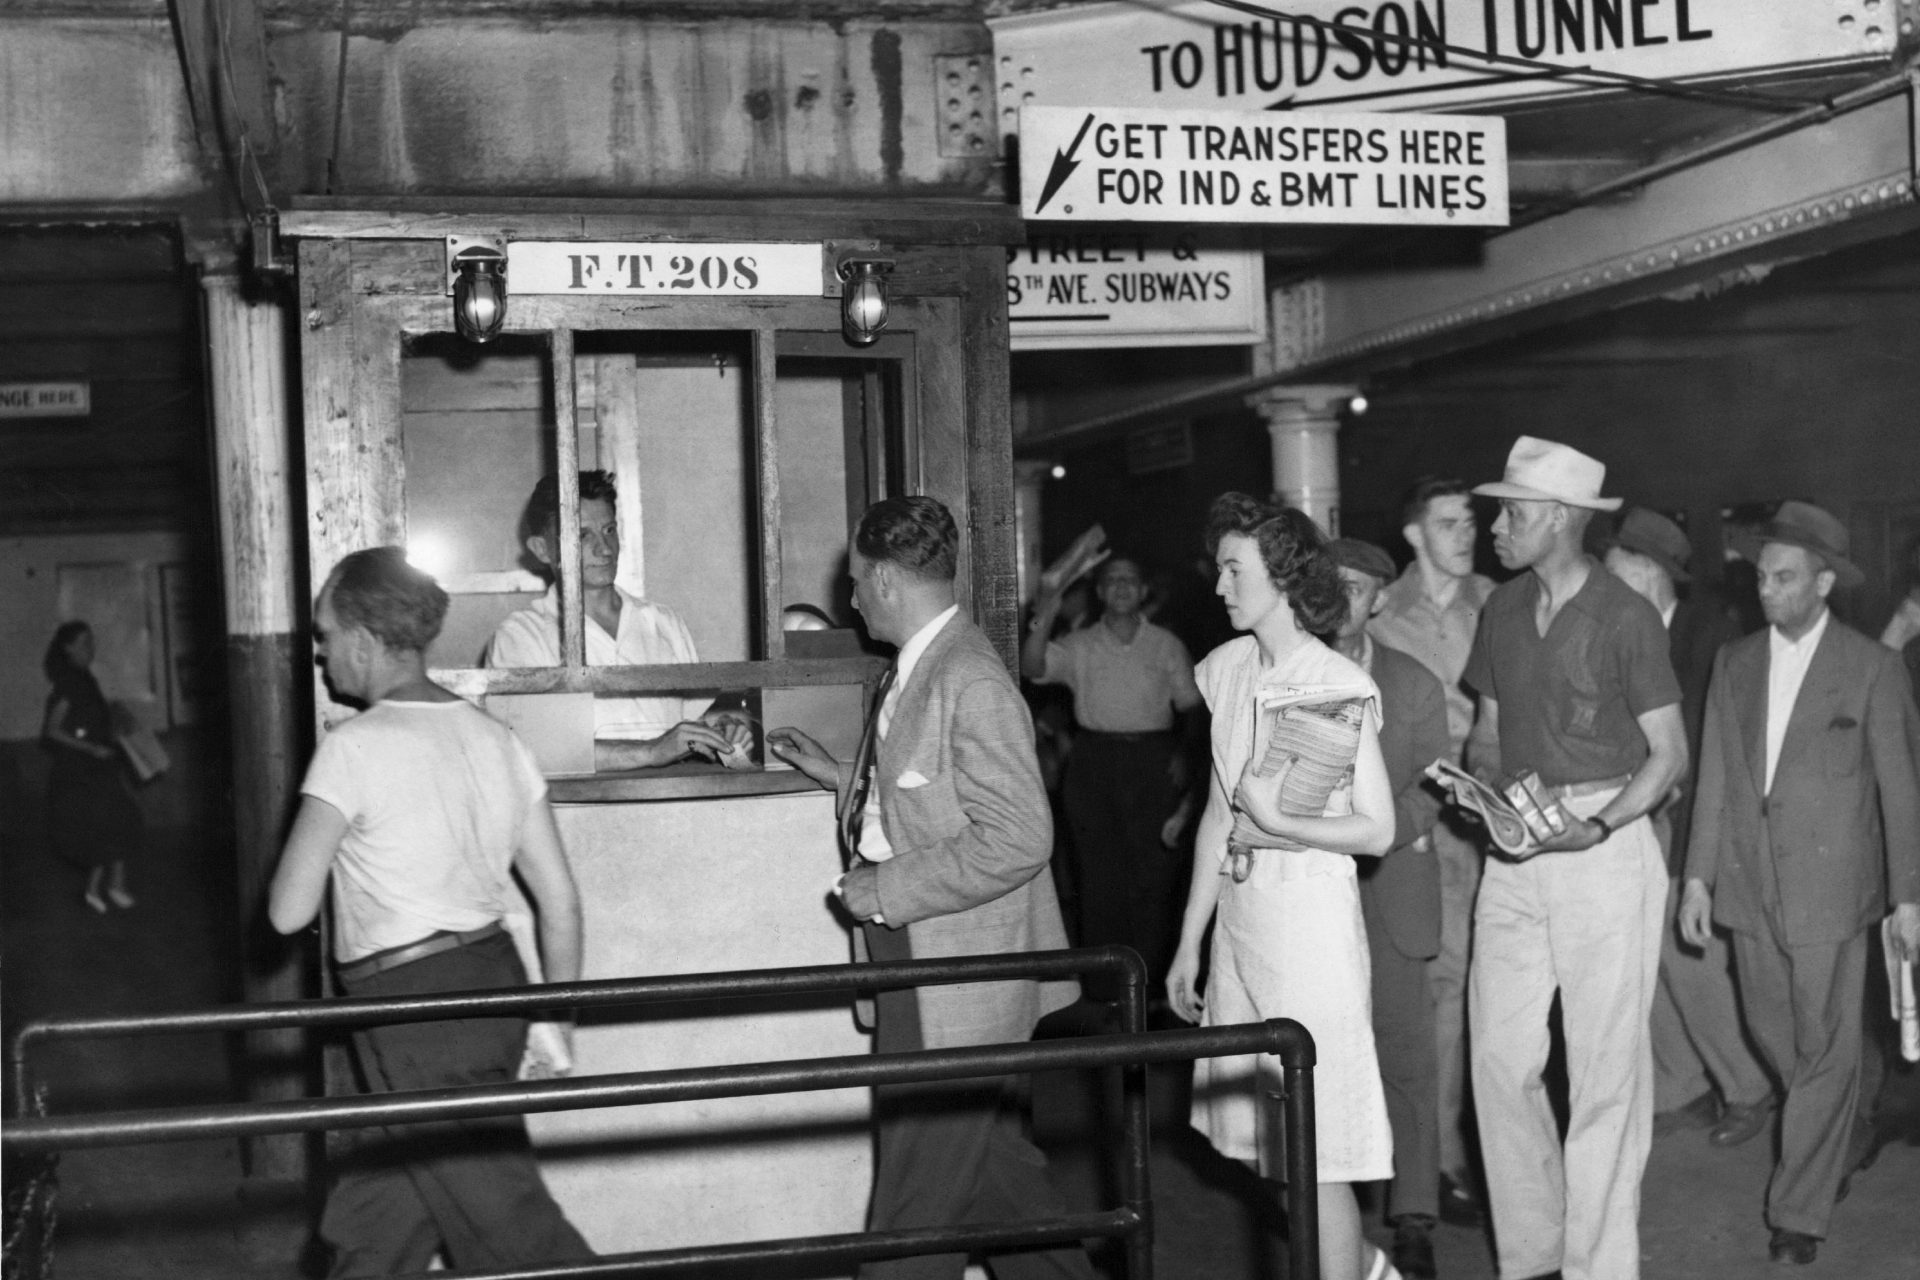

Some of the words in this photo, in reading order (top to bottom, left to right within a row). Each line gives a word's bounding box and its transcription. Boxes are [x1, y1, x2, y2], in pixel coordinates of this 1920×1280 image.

[1141, 41, 1203, 92] TO
[1214, 0, 1447, 97] HUDSON
[1484, 0, 1713, 63] TUNNEL
[1095, 123, 1168, 159] GET
[1181, 125, 1388, 163] TRANSFERS
[1400, 130, 1485, 165] HERE
[1097, 168, 1163, 204] FOR
[1180, 170, 1240, 206] IND
[1250, 179, 1271, 207] &
[1280, 171, 1358, 208] BMT
[1376, 174, 1487, 211] LINES
[568, 254, 759, 290] F.T.208
[1046, 273, 1097, 305] AVE.
[1104, 271, 1231, 304] SUBWAYS
